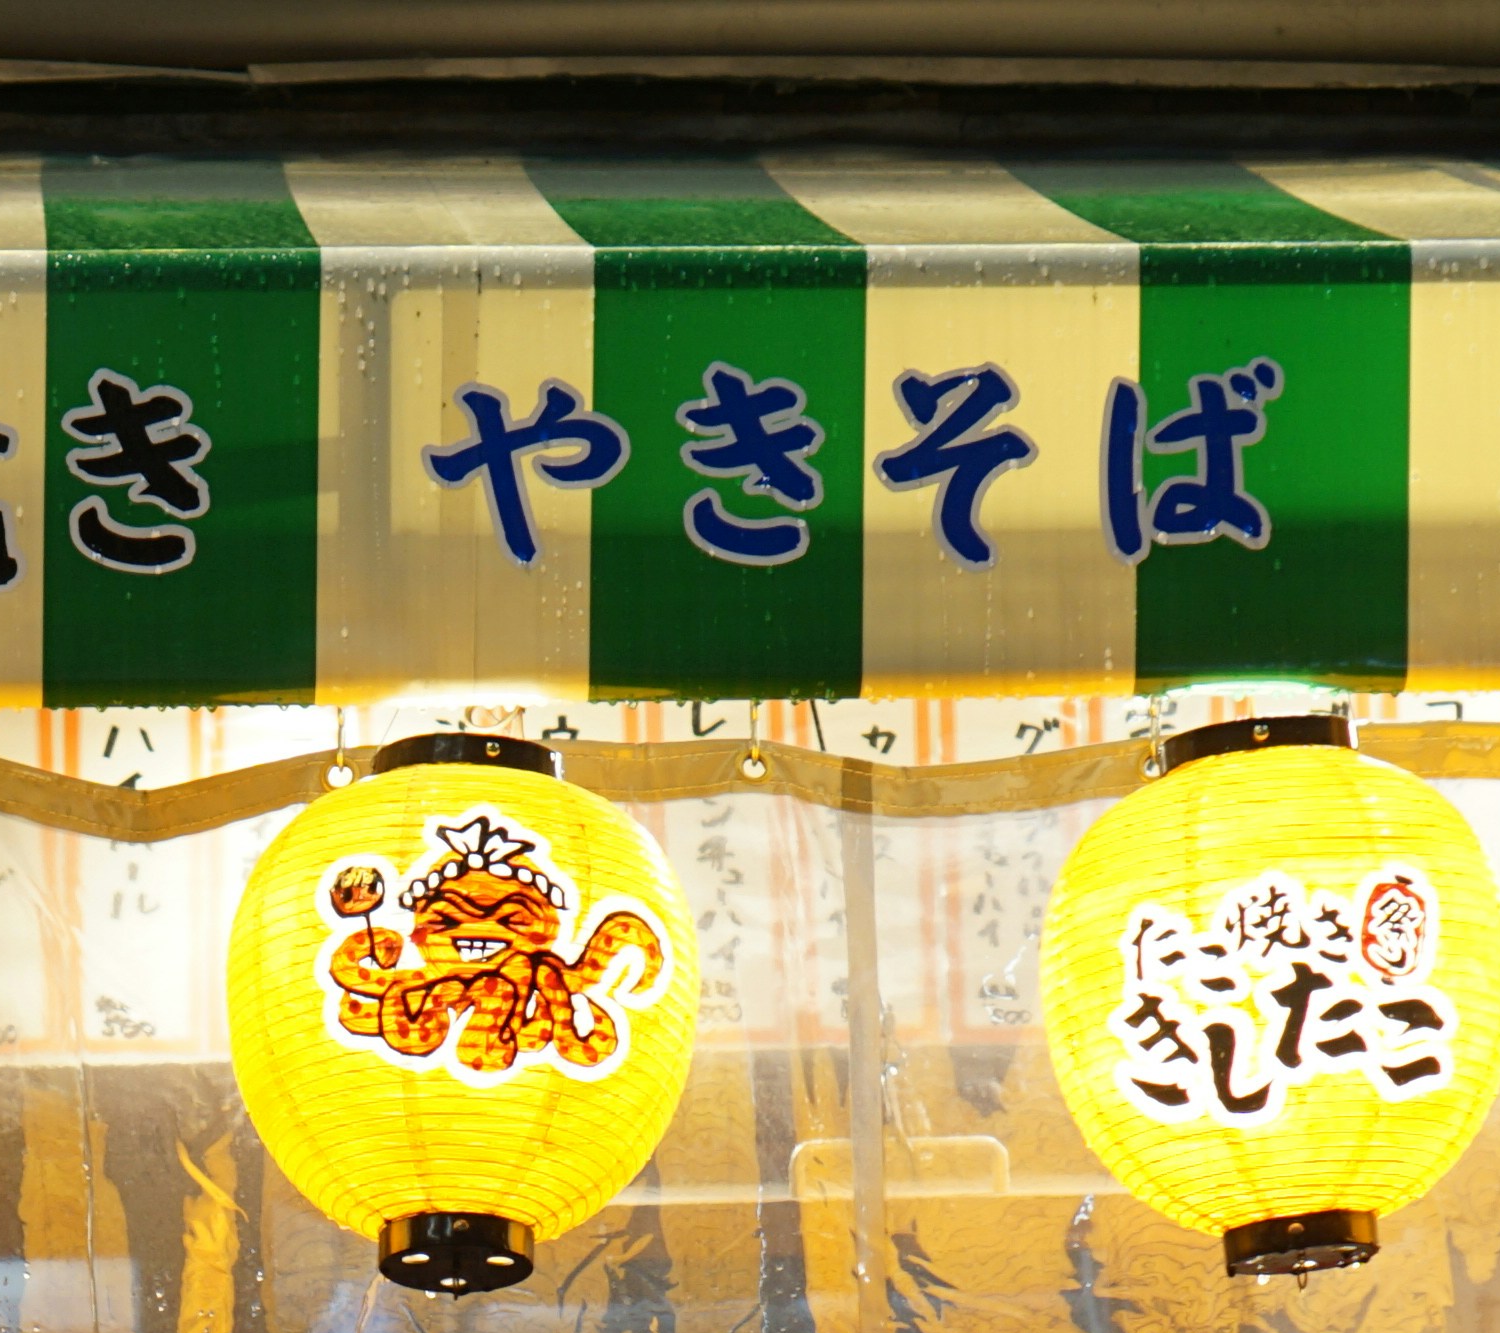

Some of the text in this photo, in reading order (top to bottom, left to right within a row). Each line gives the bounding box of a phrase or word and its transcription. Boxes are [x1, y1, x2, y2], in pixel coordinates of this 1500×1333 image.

[420, 357, 1284, 571] やきそば
[1131, 886, 1353, 991] たこ焼き
[1124, 962, 1443, 1114] きしたこ
